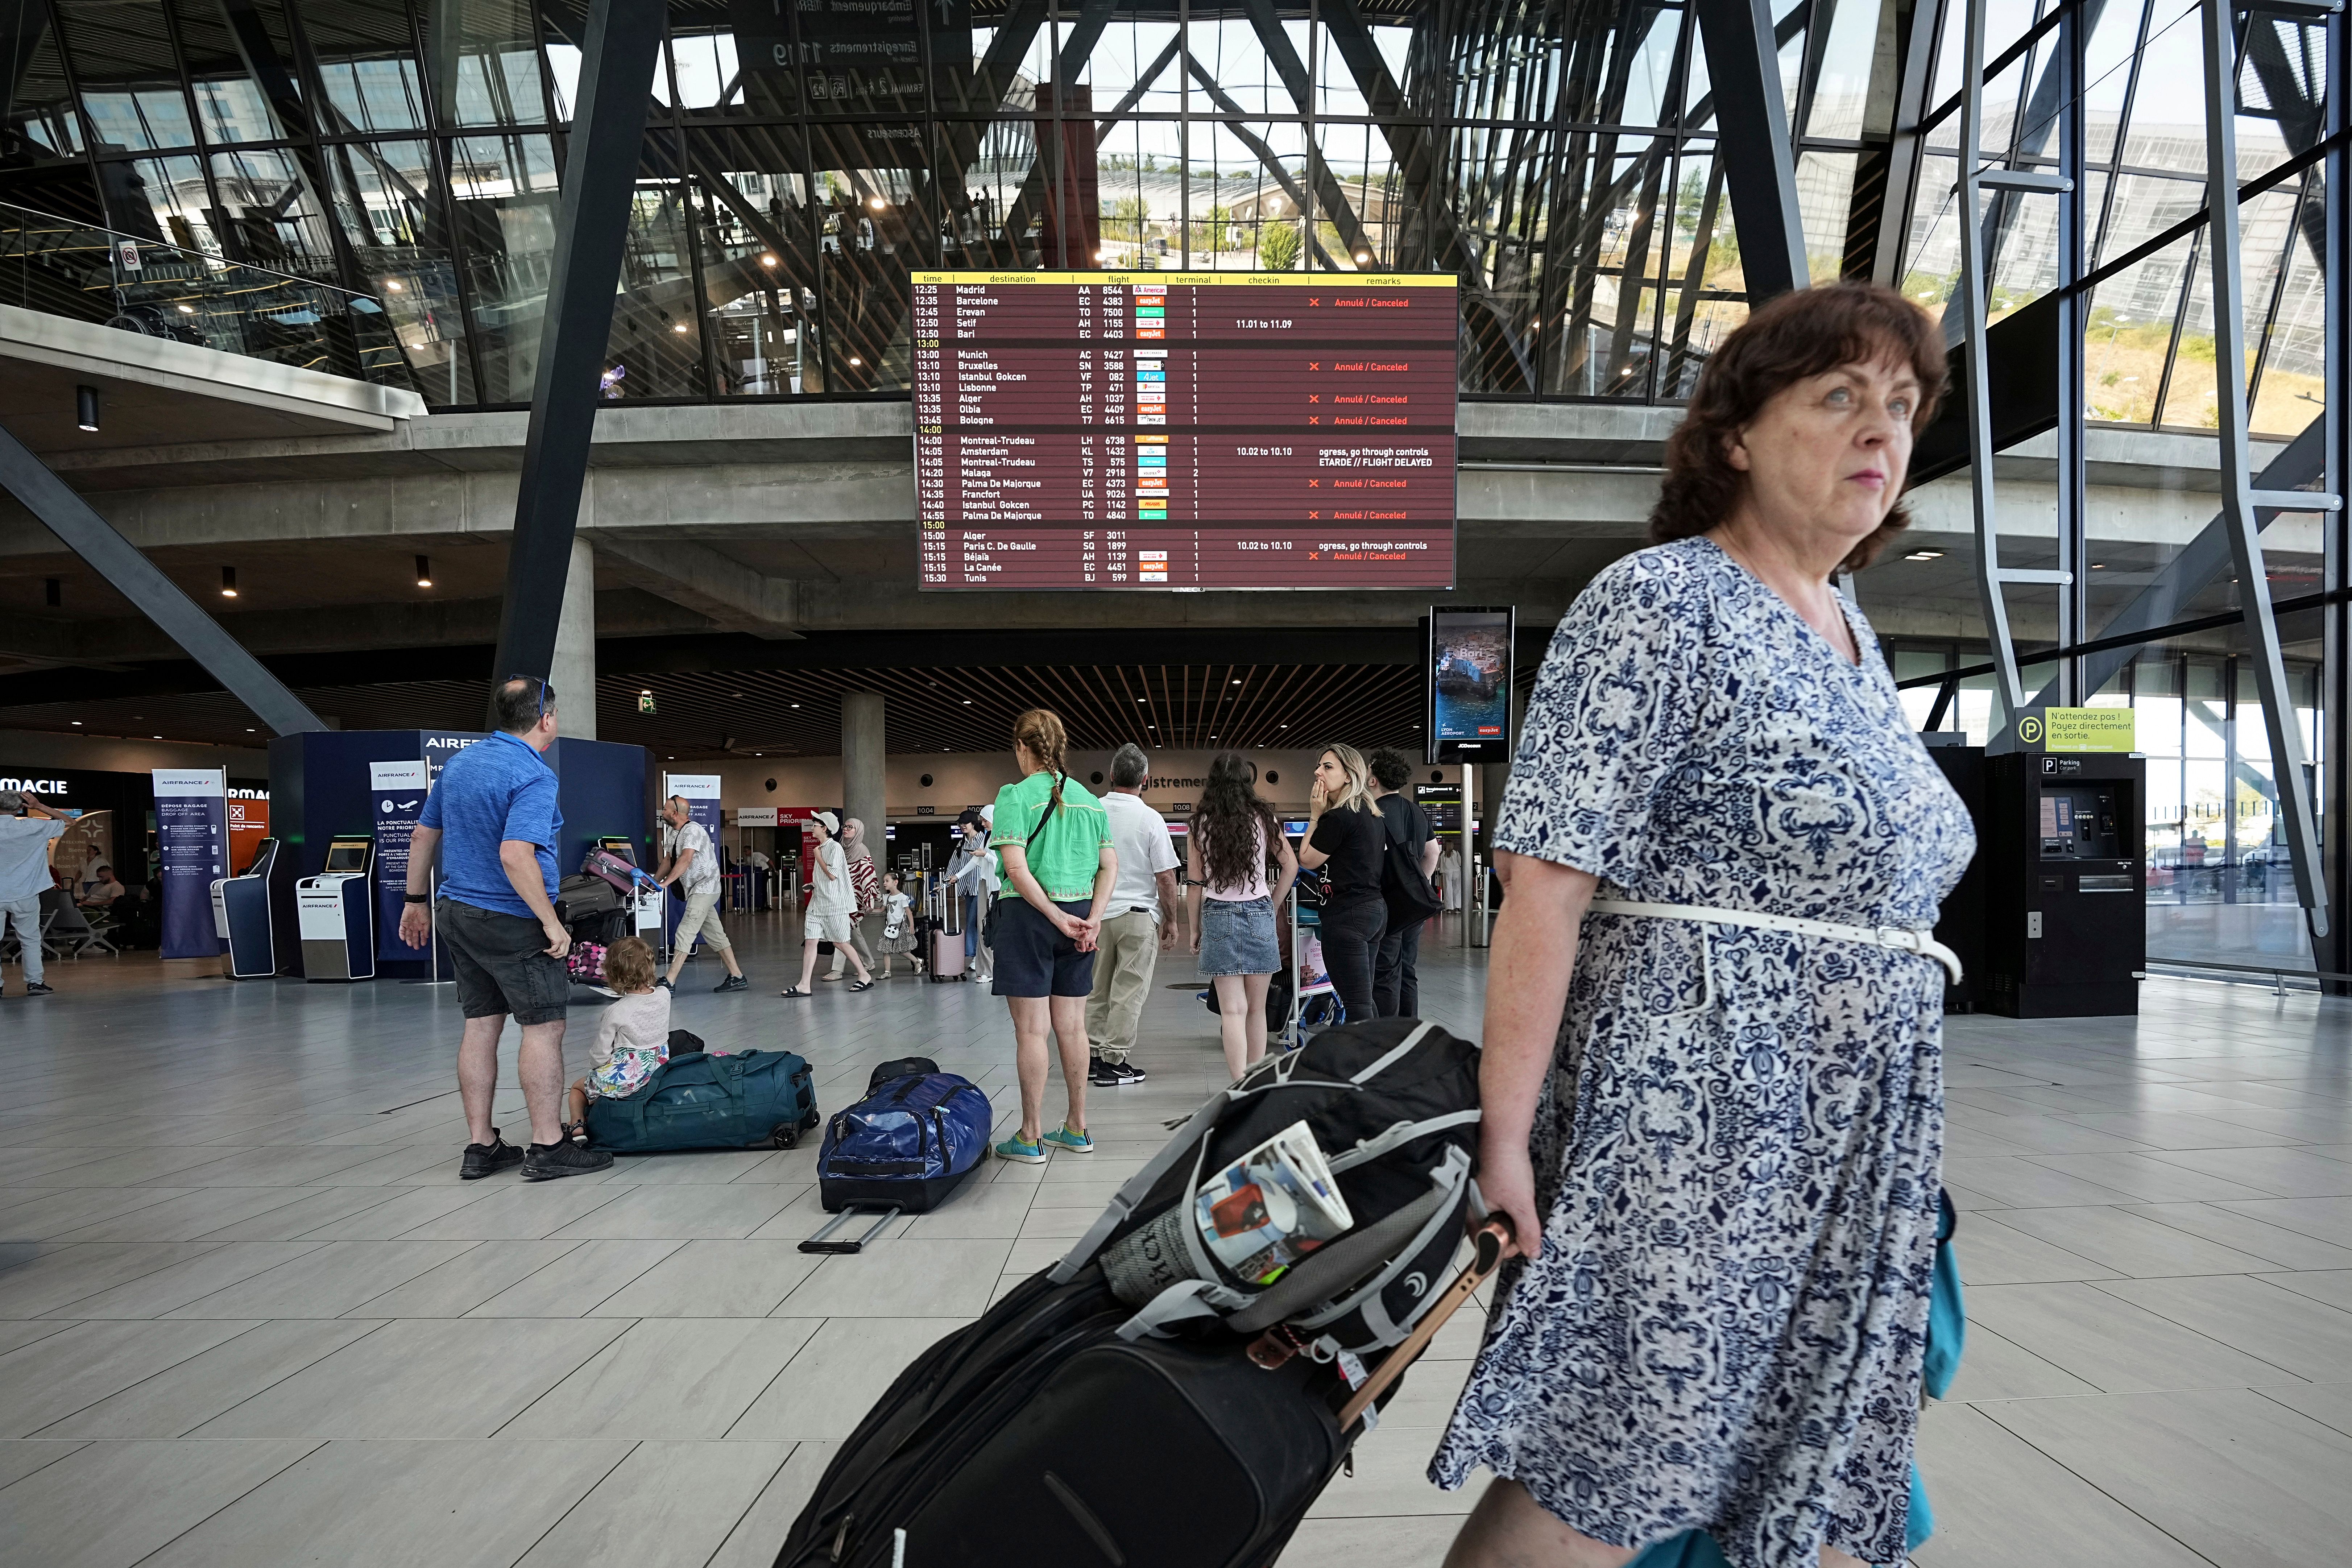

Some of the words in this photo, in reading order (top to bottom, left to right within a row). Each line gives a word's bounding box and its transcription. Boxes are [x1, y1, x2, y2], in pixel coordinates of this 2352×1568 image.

[1108, 275, 1129, 284] flight
[915, 285, 937, 294] 12:25
[956, 285, 985, 294] Madrid
[1078, 286, 1090, 294] AA
[1103, 286, 1123, 294] 8544
[915, 296, 938, 305] 12:35
[956, 297, 998, 305] Barcelone
[1079, 297, 1090, 305] EC
[1103, 297, 1123, 306] 4383
[1335, 298, 1364, 307] Annulé
[1365, 298, 1370, 307] /
[1371, 299, 1408, 307] Canceled
[957, 307, 985, 316] Erevan
[916, 318, 938, 327] 12:50
[957, 318, 976, 327] Setif
[1078, 319, 1090, 327] AH
[1103, 319, 1123, 327] 1155
[1236, 320, 1257, 328] 11.01
[1270, 320, 1292, 328] 11.09
[957, 330, 975, 338] Bari
[958, 350, 988, 359] Munich
[958, 361, 998, 370] Bruxelles
[958, 372, 992, 381] Istanbul
[996, 372, 1026, 381] Gokcen
[959, 383, 997, 392] Lisbonne
[959, 394, 982, 403] Alger
[960, 405, 981, 413] Olbia
[960, 416, 994, 425] Bologne
[961, 436, 1035, 444] Montreal-Trudeau
[920, 447, 942, 455] 14:05
[960, 447, 1008, 455] Amsterdam
[1082, 447, 1093, 455] KL
[1106, 447, 1125, 455] 1432
[1237, 447, 1258, 455] 10.02
[1271, 447, 1292, 456] 10.10
[1319, 449, 1349, 458] ogress,
[1350, 449, 1361, 458] go
[1362, 447, 1394, 458] through
[1395, 447, 1429, 456] controls
[1319, 458, 1352, 466] ETARDE
[1353, 457, 1361, 467] //
[1363, 458, 1393, 466] FLIGHT
[961, 468, 991, 478] Malaga
[962, 479, 988, 488] Palma
[990, 479, 1001, 488] De
[1003, 479, 1041, 488] Majorque
[962, 490, 1000, 498] Francfort
[962, 501, 996, 509] Istanbul
[963, 511, 989, 520] Palma
[991, 511, 1002, 520] De
[1004, 511, 1042, 520] Majorque
[963, 531, 986, 541] Alger
[964, 542, 985, 550] Paris
[964, 552, 989, 562] Béjaïa
[964, 563, 974, 571] La
[976, 563, 1002, 571] Canée
[964, 574, 987, 582] Tunis
[1460, 648, 1483, 657] Bari
[2051, 712, 2098, 720] N'attendez
[2026, 722, 2037, 738] P
[2051, 722, 2077, 731] Payez
[2046, 760, 2053, 771] P
